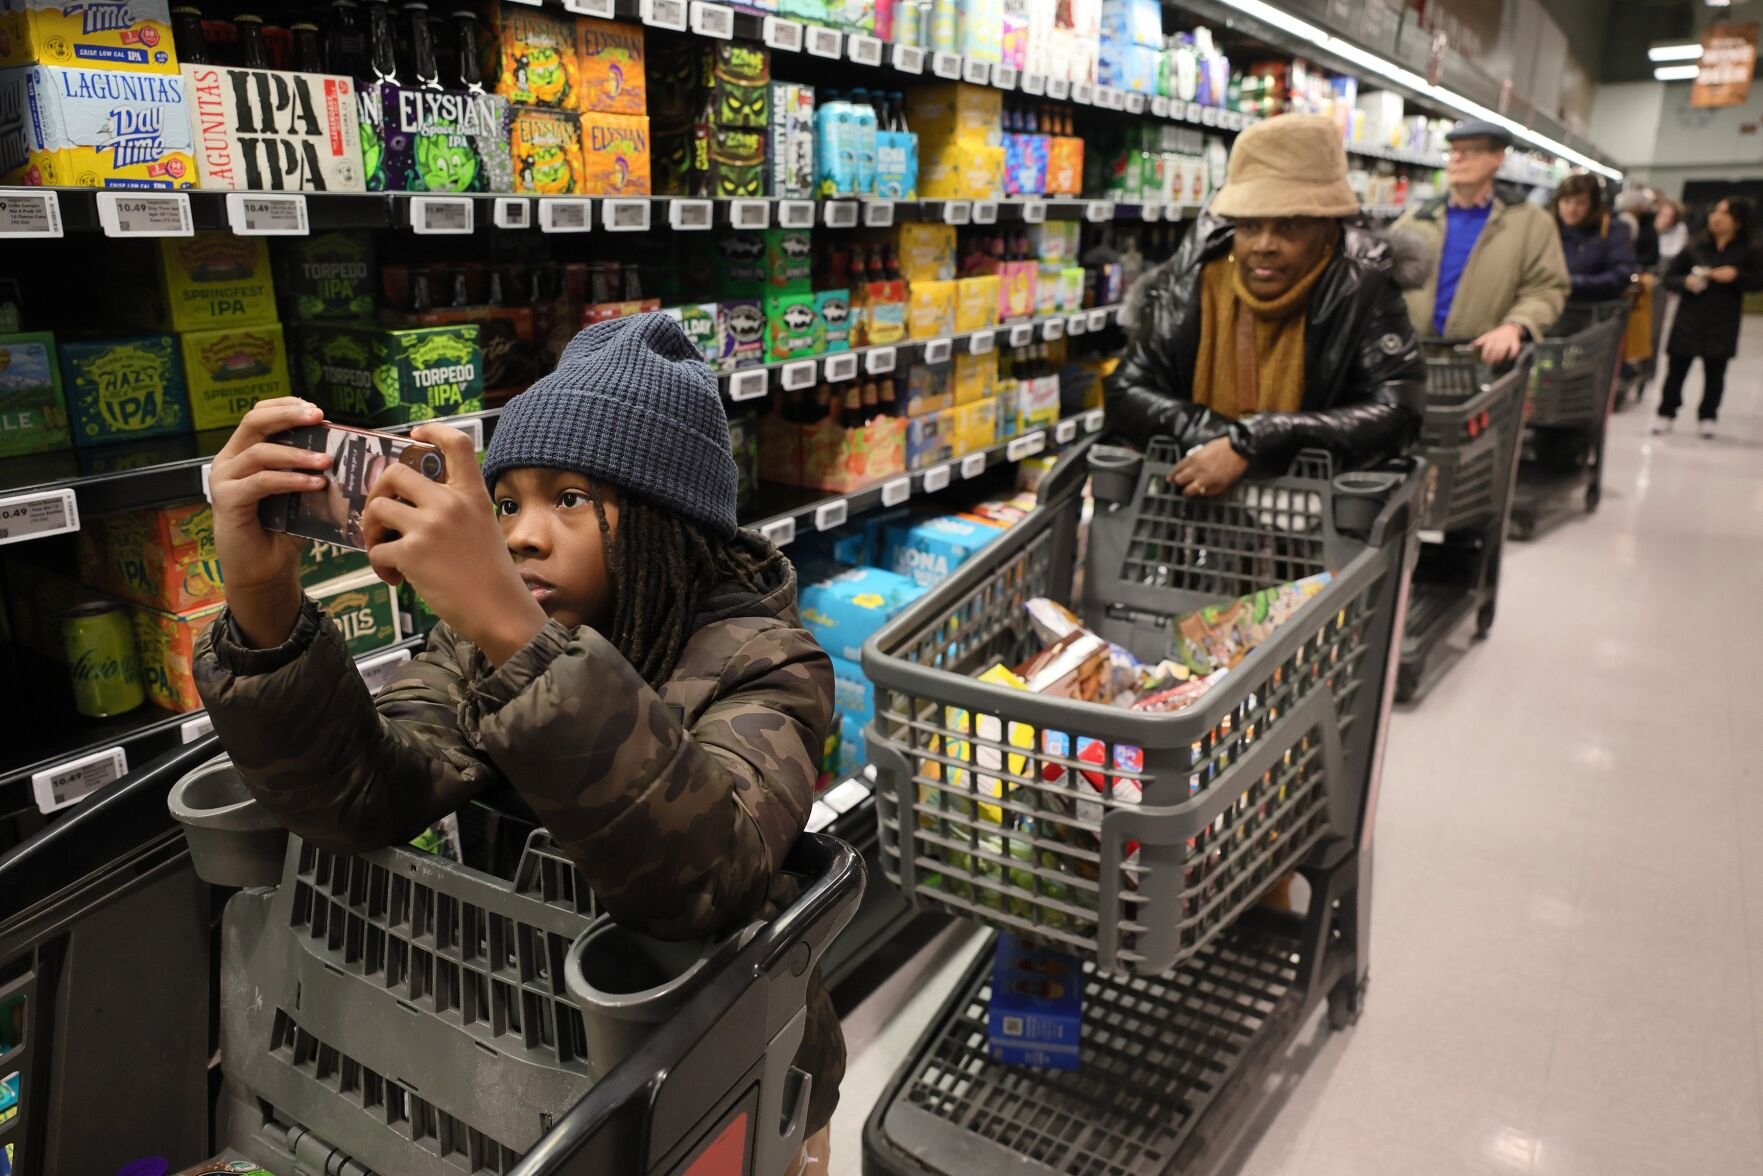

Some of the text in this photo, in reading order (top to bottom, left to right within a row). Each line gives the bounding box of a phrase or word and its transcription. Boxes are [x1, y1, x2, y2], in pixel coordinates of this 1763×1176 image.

[127, 51, 142, 61] IPA
[61, 71, 182, 104] LAGUNITAS
[226, 69, 323, 136] IPA
[399, 90, 497, 137] ELYSIAN
[110, 105, 165, 137] Day
[448, 135, 468, 148] IPA
[591, 125, 647, 152] ELYSIAN
[96, 134, 165, 170] Time
[237, 137, 328, 190] IPA
[118, 203, 147, 212] 10.49
[244, 204, 270, 212] 10.49
[303, 262, 368, 280] TORPEDO
[183, 285, 265, 302] SPRINGFEST
[209, 300, 246, 317] IPA
[99, 365, 158, 391] HAZY
[322, 364, 372, 388] TORPEDO
[412, 363, 475, 388] TORPEDO
[202, 381, 281, 401] SPRINGFEST
[104, 389, 158, 426] IPA
[53, 772, 82, 788] 10.49
